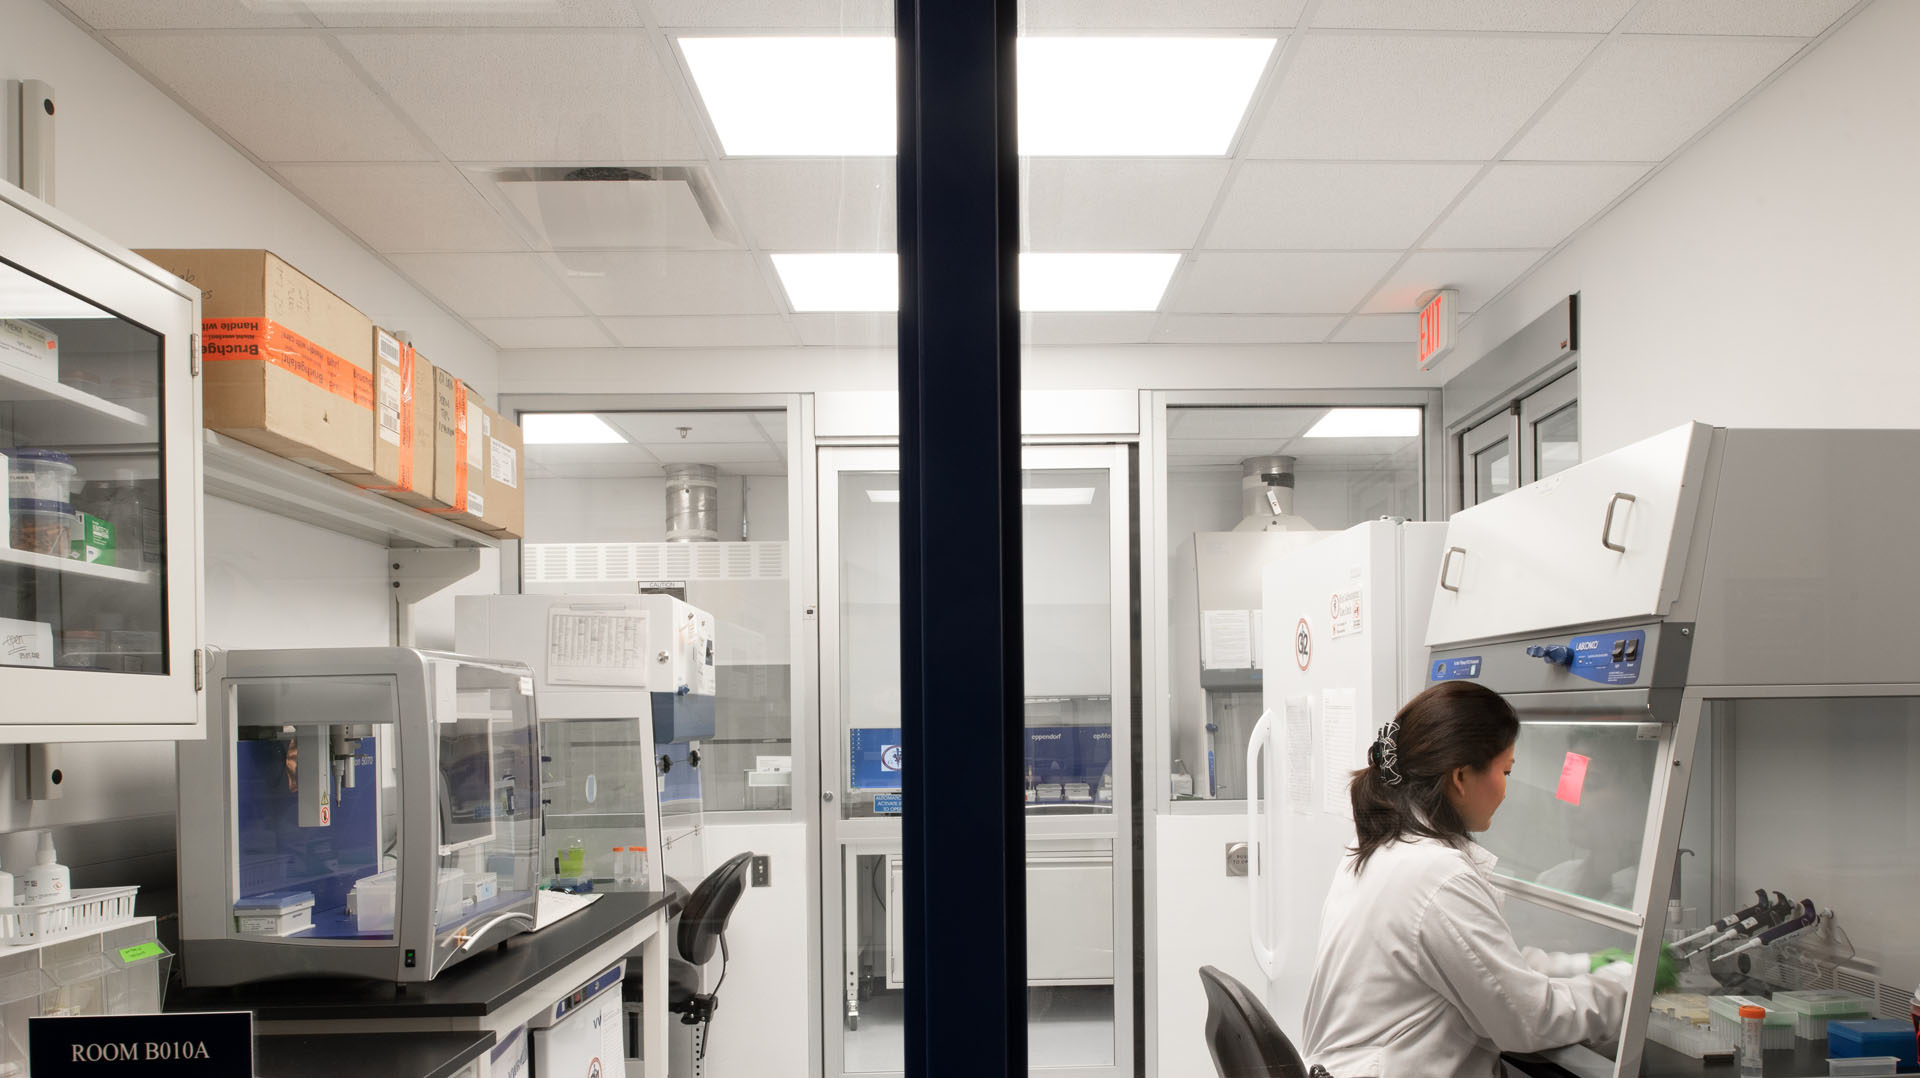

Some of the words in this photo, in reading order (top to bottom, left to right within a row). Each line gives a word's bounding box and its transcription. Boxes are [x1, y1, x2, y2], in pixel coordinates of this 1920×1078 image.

[220, 322, 259, 331] Handle
[1420, 295, 1442, 362] EXIT
[202, 342, 259, 356] Bruchge
[1031, 733, 1062, 742] eppendorf
[71, 1043, 139, 1062] ROOM
[144, 1040, 210, 1060] B010A
